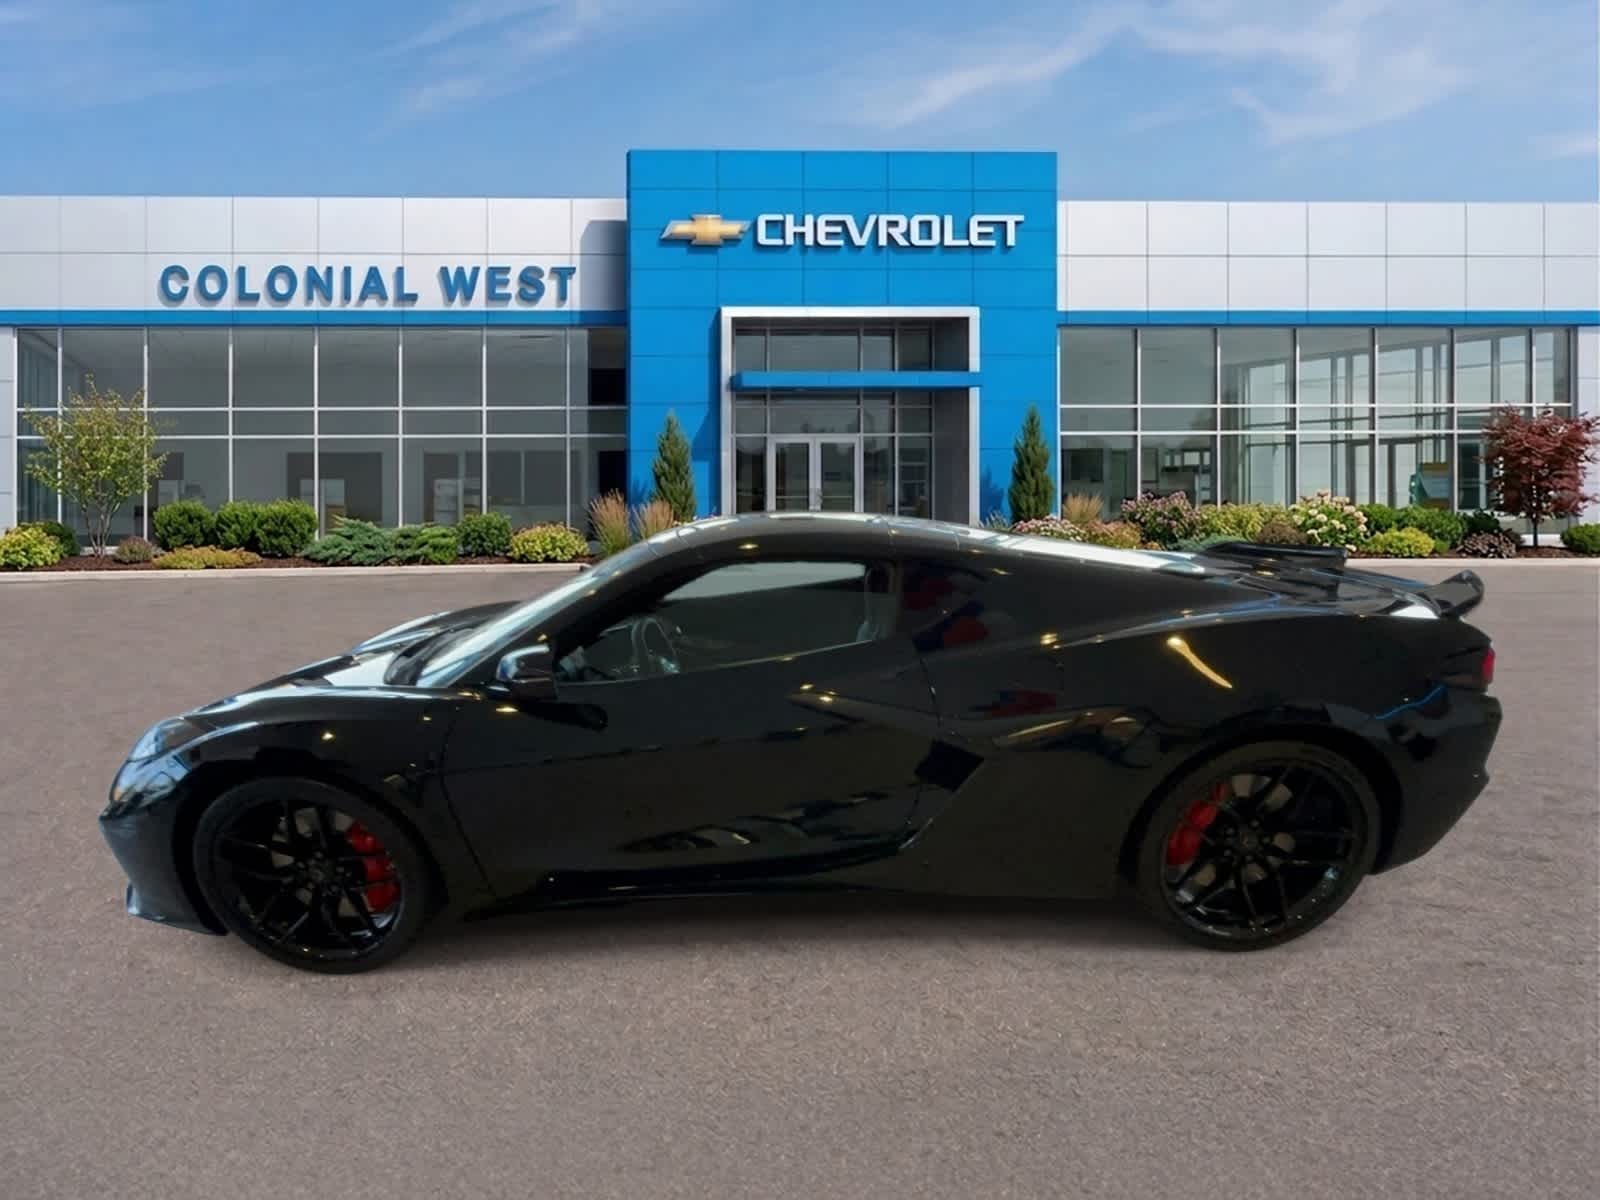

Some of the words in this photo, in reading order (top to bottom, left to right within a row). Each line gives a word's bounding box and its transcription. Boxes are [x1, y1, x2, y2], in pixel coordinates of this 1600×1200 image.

[756, 213, 1025, 248] CHEVROLET
[159, 264, 419, 304] COLONIAL
[437, 265, 577, 304] WEST
